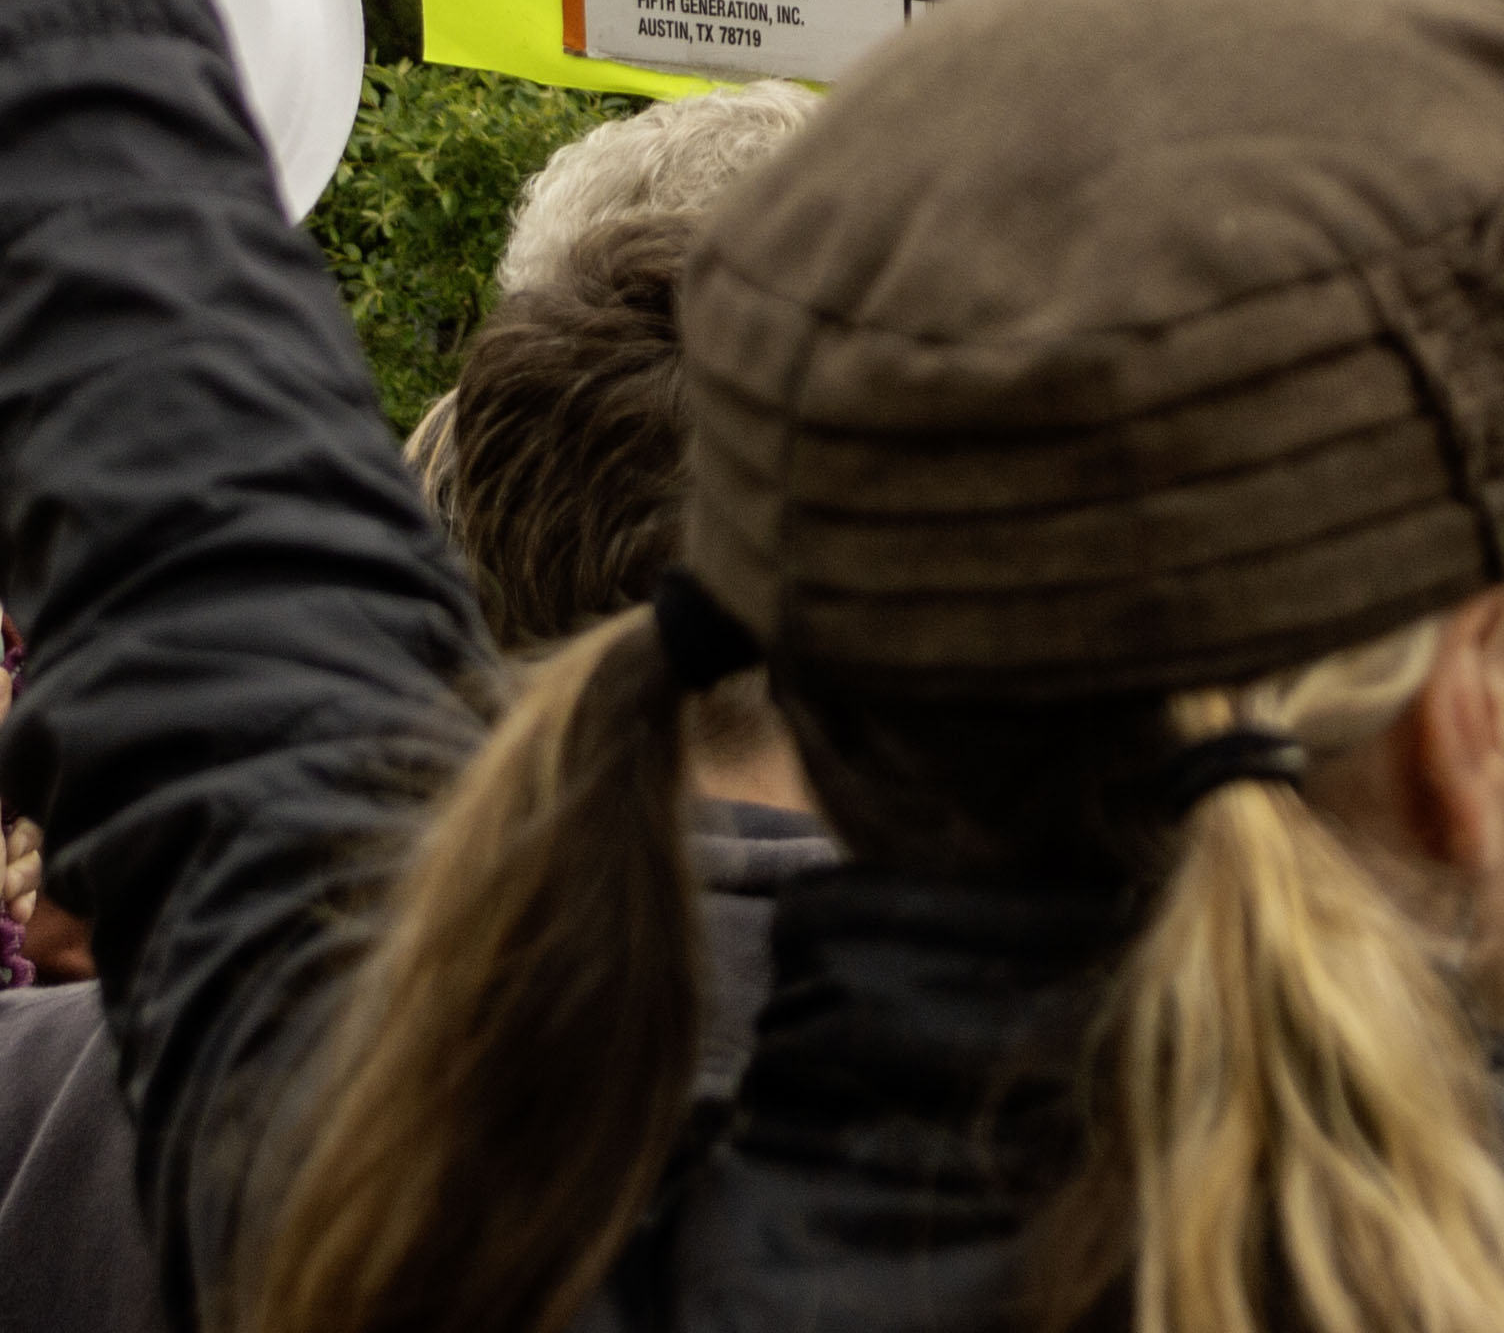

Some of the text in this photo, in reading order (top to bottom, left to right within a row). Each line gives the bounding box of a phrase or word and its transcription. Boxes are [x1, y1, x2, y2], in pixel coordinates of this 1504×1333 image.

[776, 5, 806, 27] INC.
[638, 17, 762, 48] AUSTIN, TX 78719
